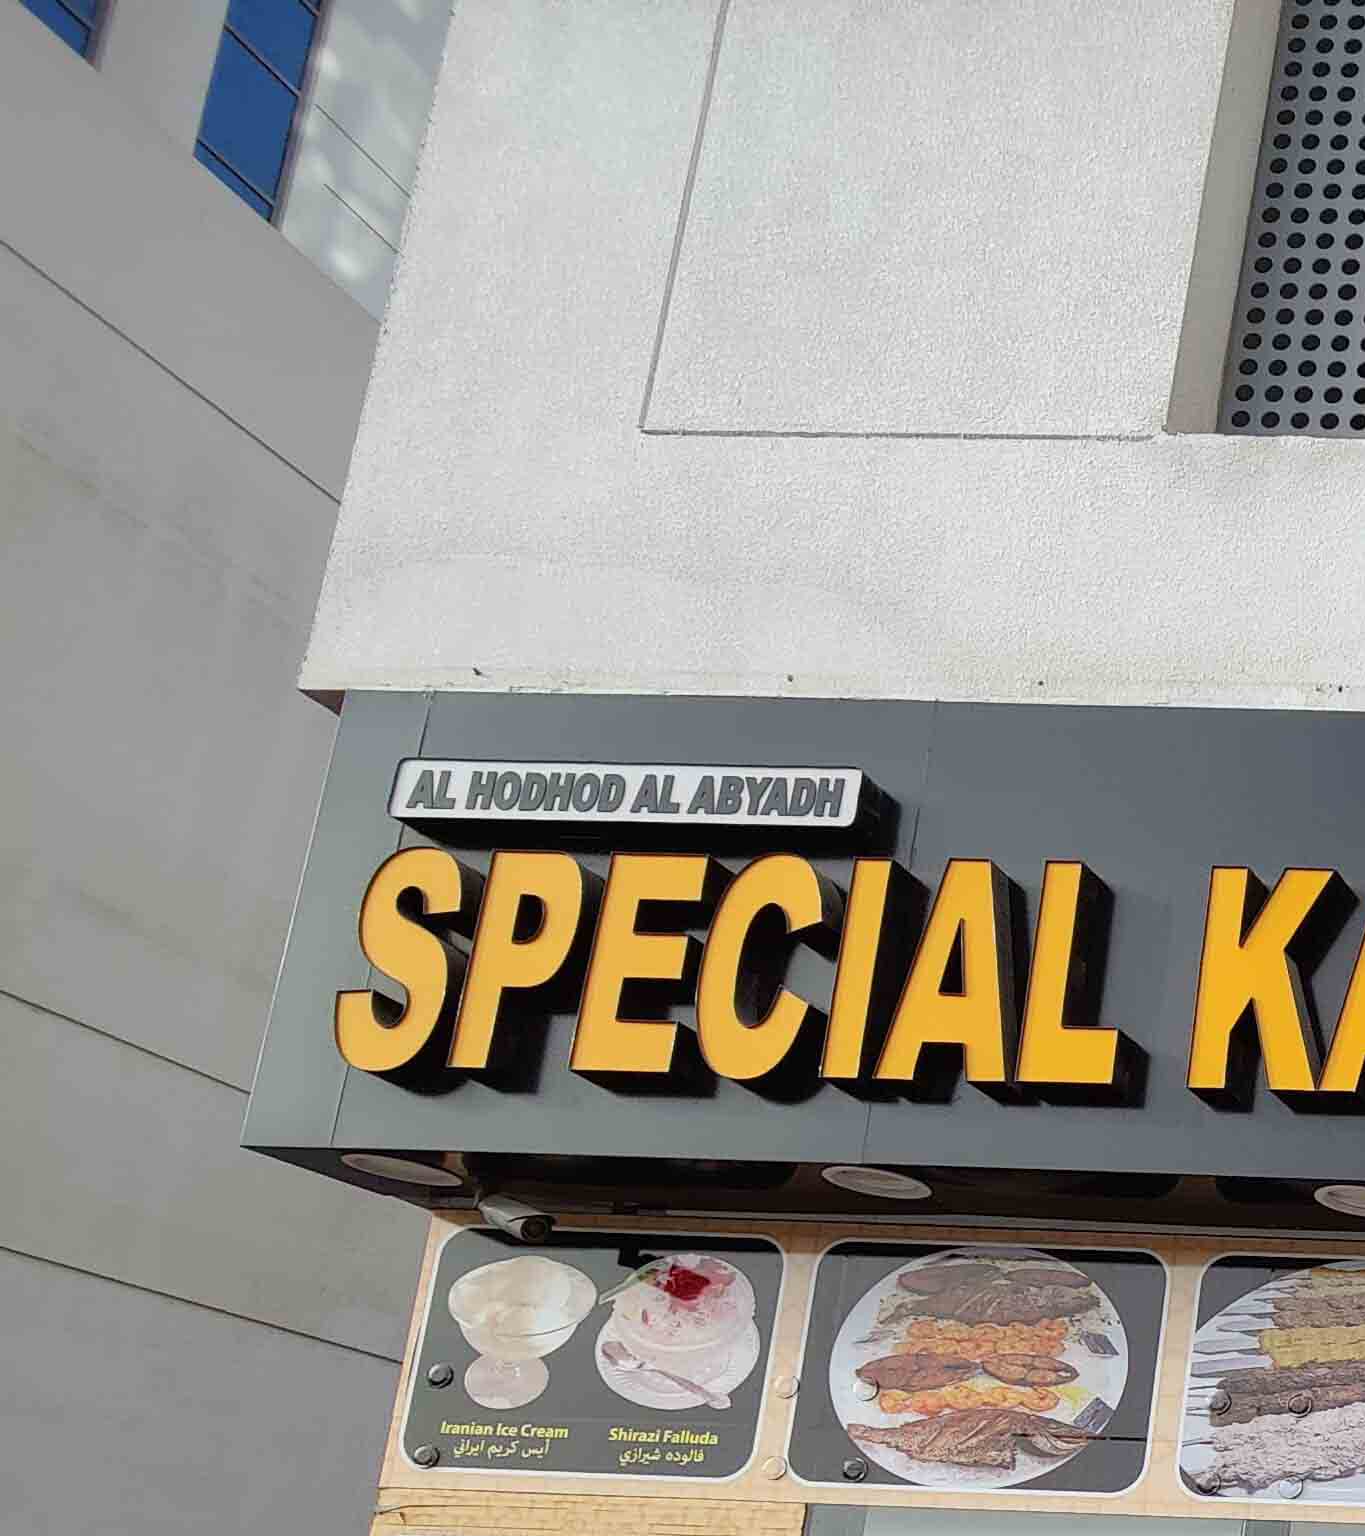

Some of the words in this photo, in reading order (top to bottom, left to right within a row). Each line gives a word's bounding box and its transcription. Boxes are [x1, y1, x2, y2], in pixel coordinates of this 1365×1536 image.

[406, 770, 456, 809] AL
[465, 771, 626, 813] HODHOD
[630, 775, 680, 815] AL
[687, 776, 845, 818] ABYADH
[335, 846, 1118, 1084] SPECIAL
[440, 1421, 493, 1436] Iranian
[496, 1423, 518, 1437] Ice
[520, 1423, 569, 1439] Cream
[608, 1427, 661, 1443] Shirazi
[662, 1429, 718, 1446] Falluda
[486, 1439, 520, 1460] كريم
